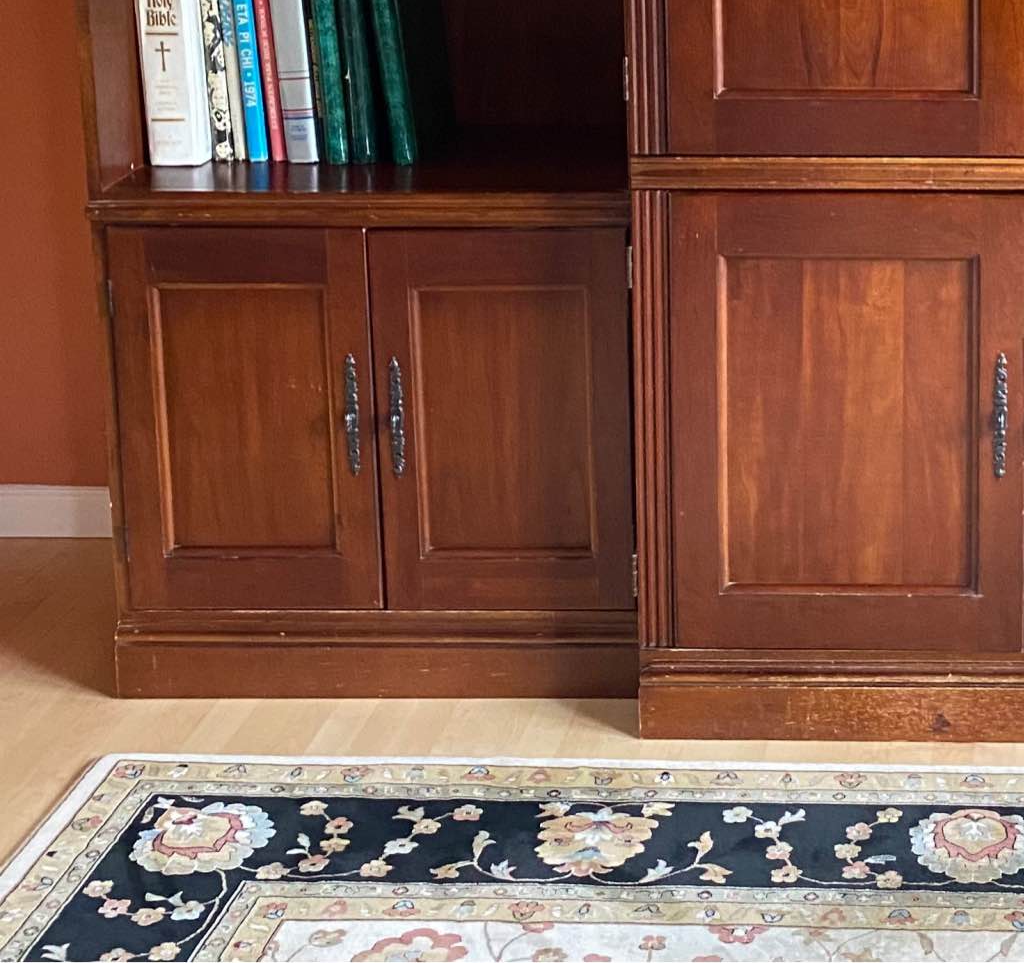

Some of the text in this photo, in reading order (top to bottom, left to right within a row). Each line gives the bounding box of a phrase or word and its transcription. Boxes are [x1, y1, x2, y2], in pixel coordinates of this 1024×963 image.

[146, 11, 176, 26] Bible
[236, 4, 256, 107] ETA PI CHI 1974
